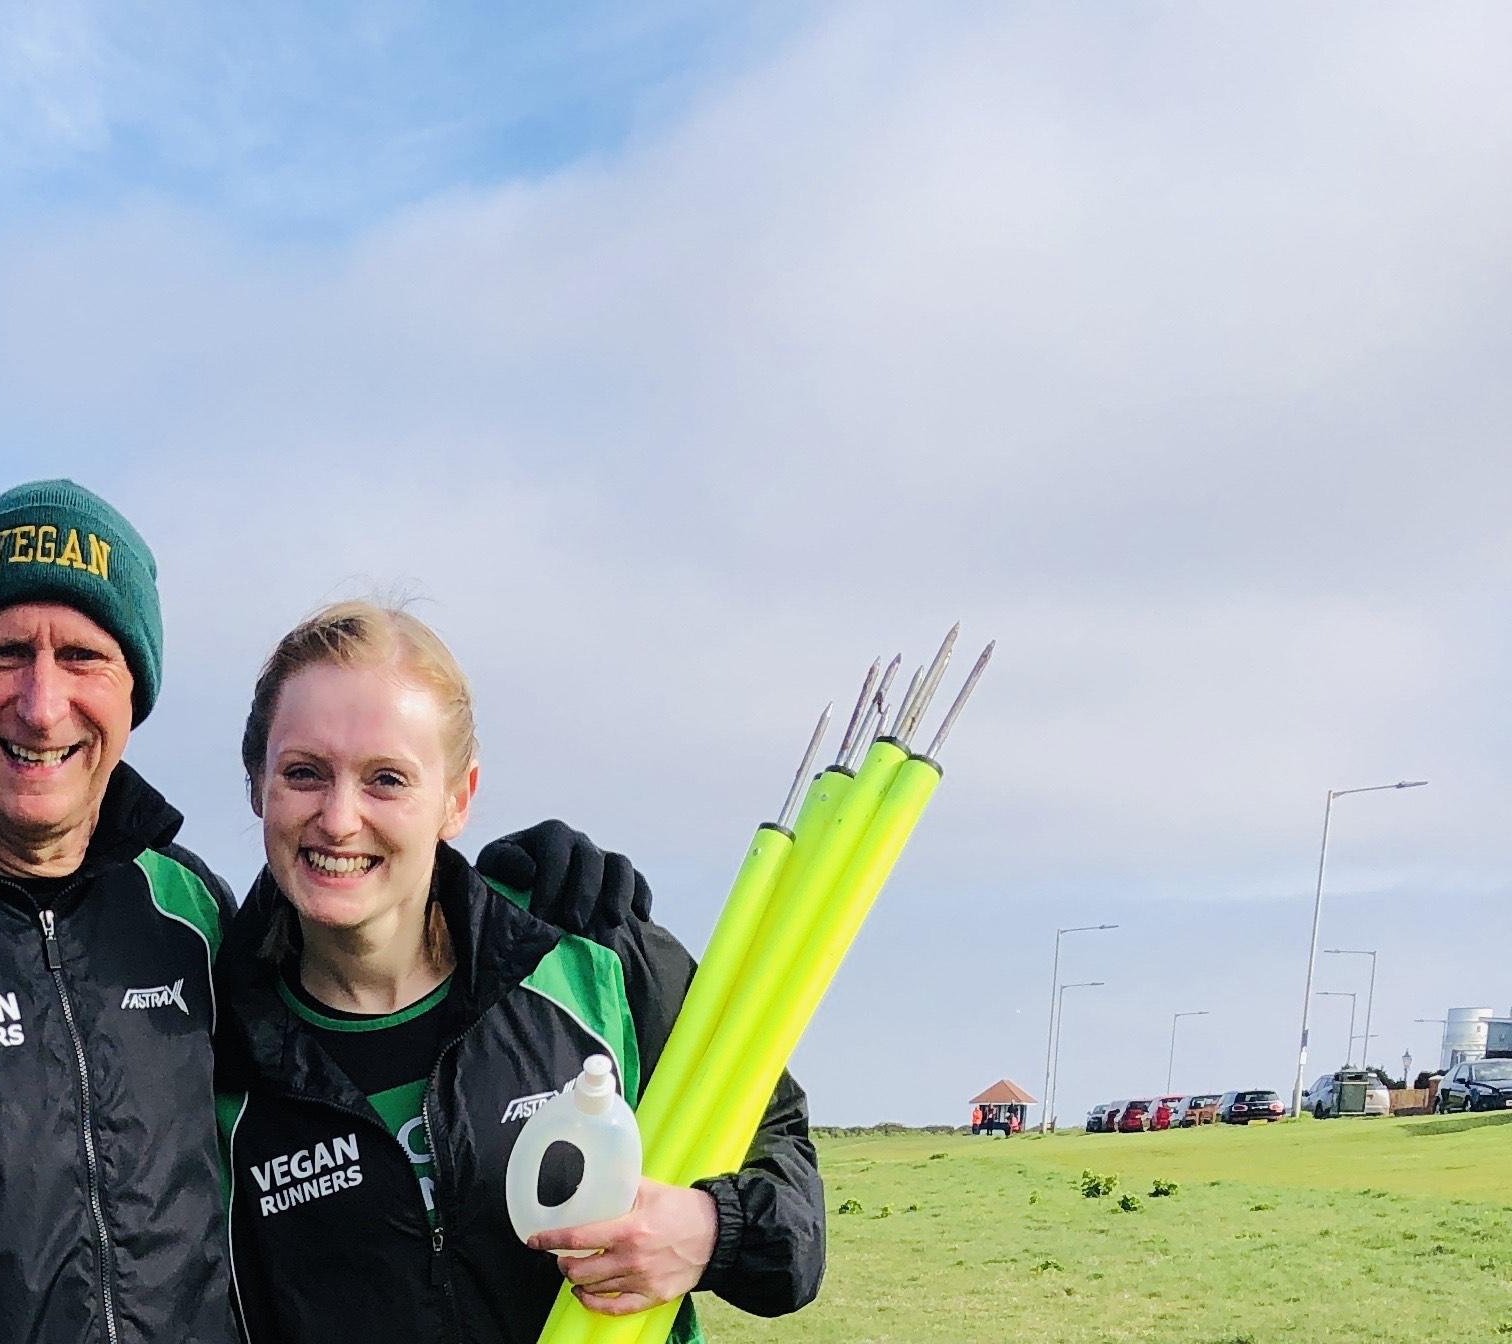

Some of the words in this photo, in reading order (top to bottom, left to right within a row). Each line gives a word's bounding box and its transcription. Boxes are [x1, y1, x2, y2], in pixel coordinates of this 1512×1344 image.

[121, 978, 189, 1015] FASTRAX
[501, 1078, 577, 1123] FAST
[250, 1133, 360, 1193] VEGAN
[259, 1165, 364, 1217] RUNNERS
